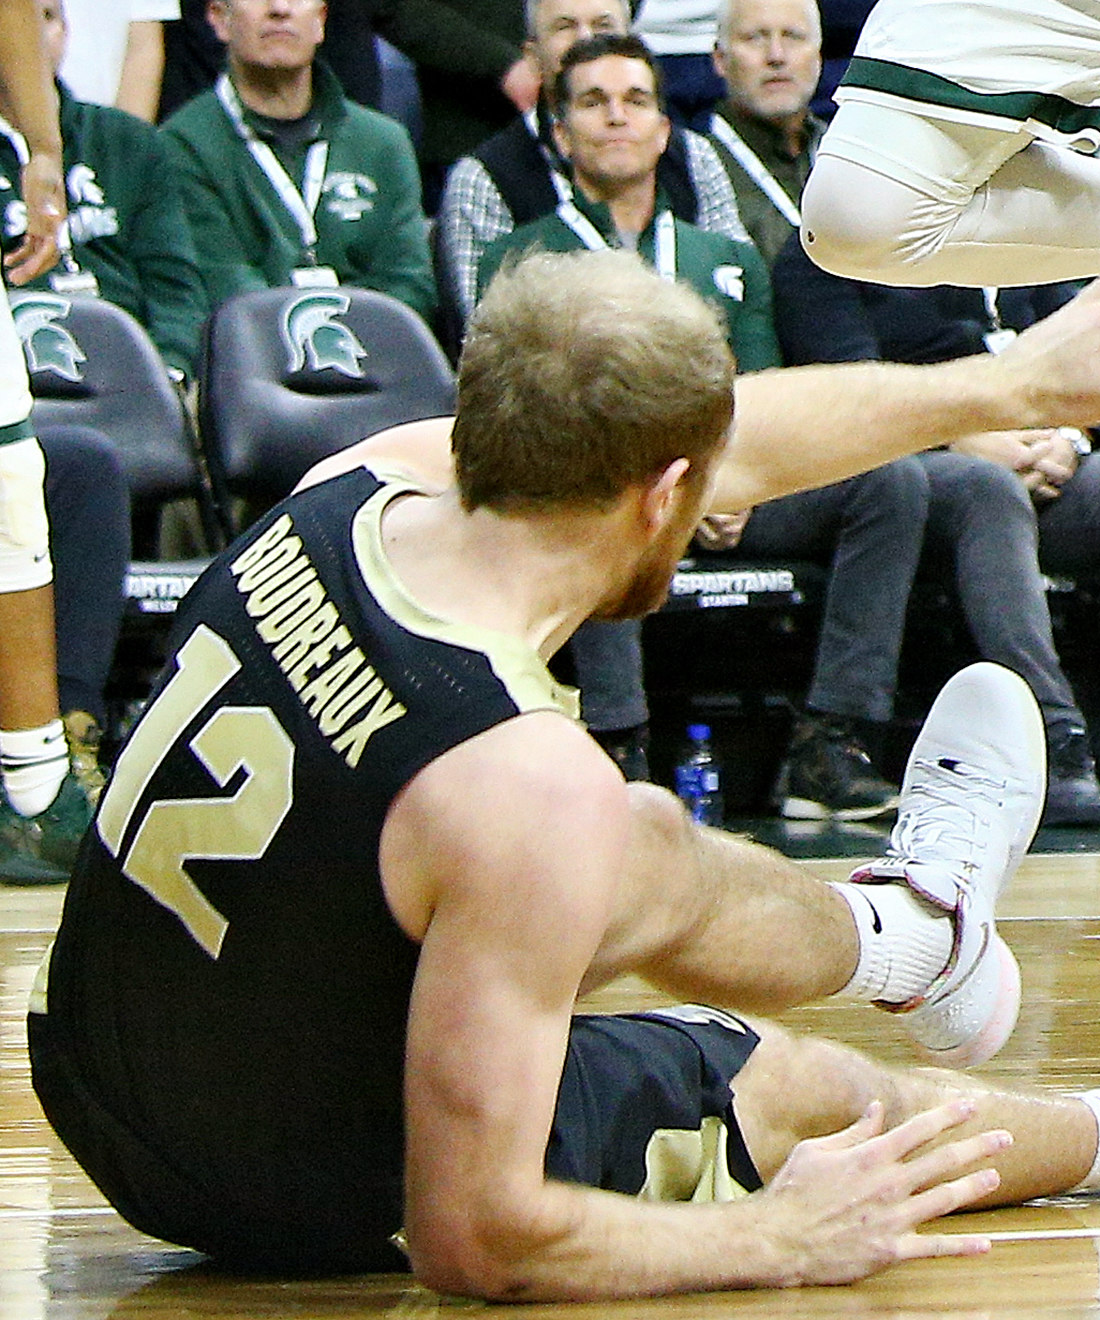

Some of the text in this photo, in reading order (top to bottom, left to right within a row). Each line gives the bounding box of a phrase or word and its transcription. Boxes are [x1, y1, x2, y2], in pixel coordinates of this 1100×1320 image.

[230, 513, 407, 768] BOUDREAUX
[671, 570, 794, 596] SPARTANS
[97, 623, 296, 959] 12
